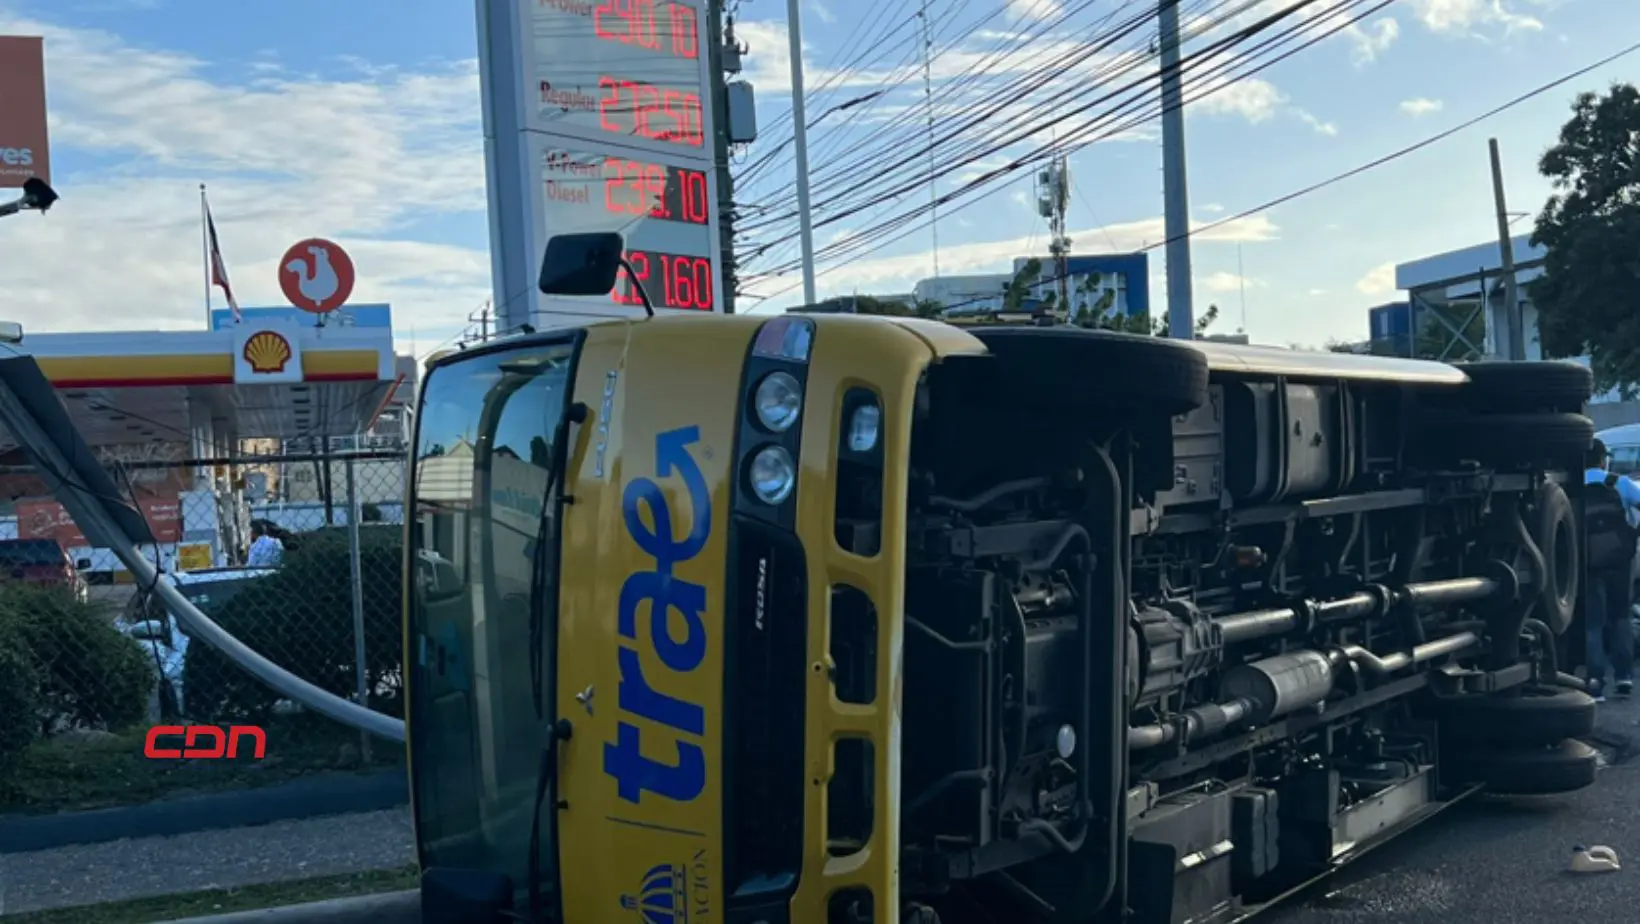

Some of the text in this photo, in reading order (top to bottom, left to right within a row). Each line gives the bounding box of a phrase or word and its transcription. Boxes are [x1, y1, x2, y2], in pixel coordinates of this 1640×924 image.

[541, 79, 595, 113] Regular
[546, 179, 590, 204] Diesel
[604, 157, 707, 223] 239.10
[603, 424, 712, 804] trae
